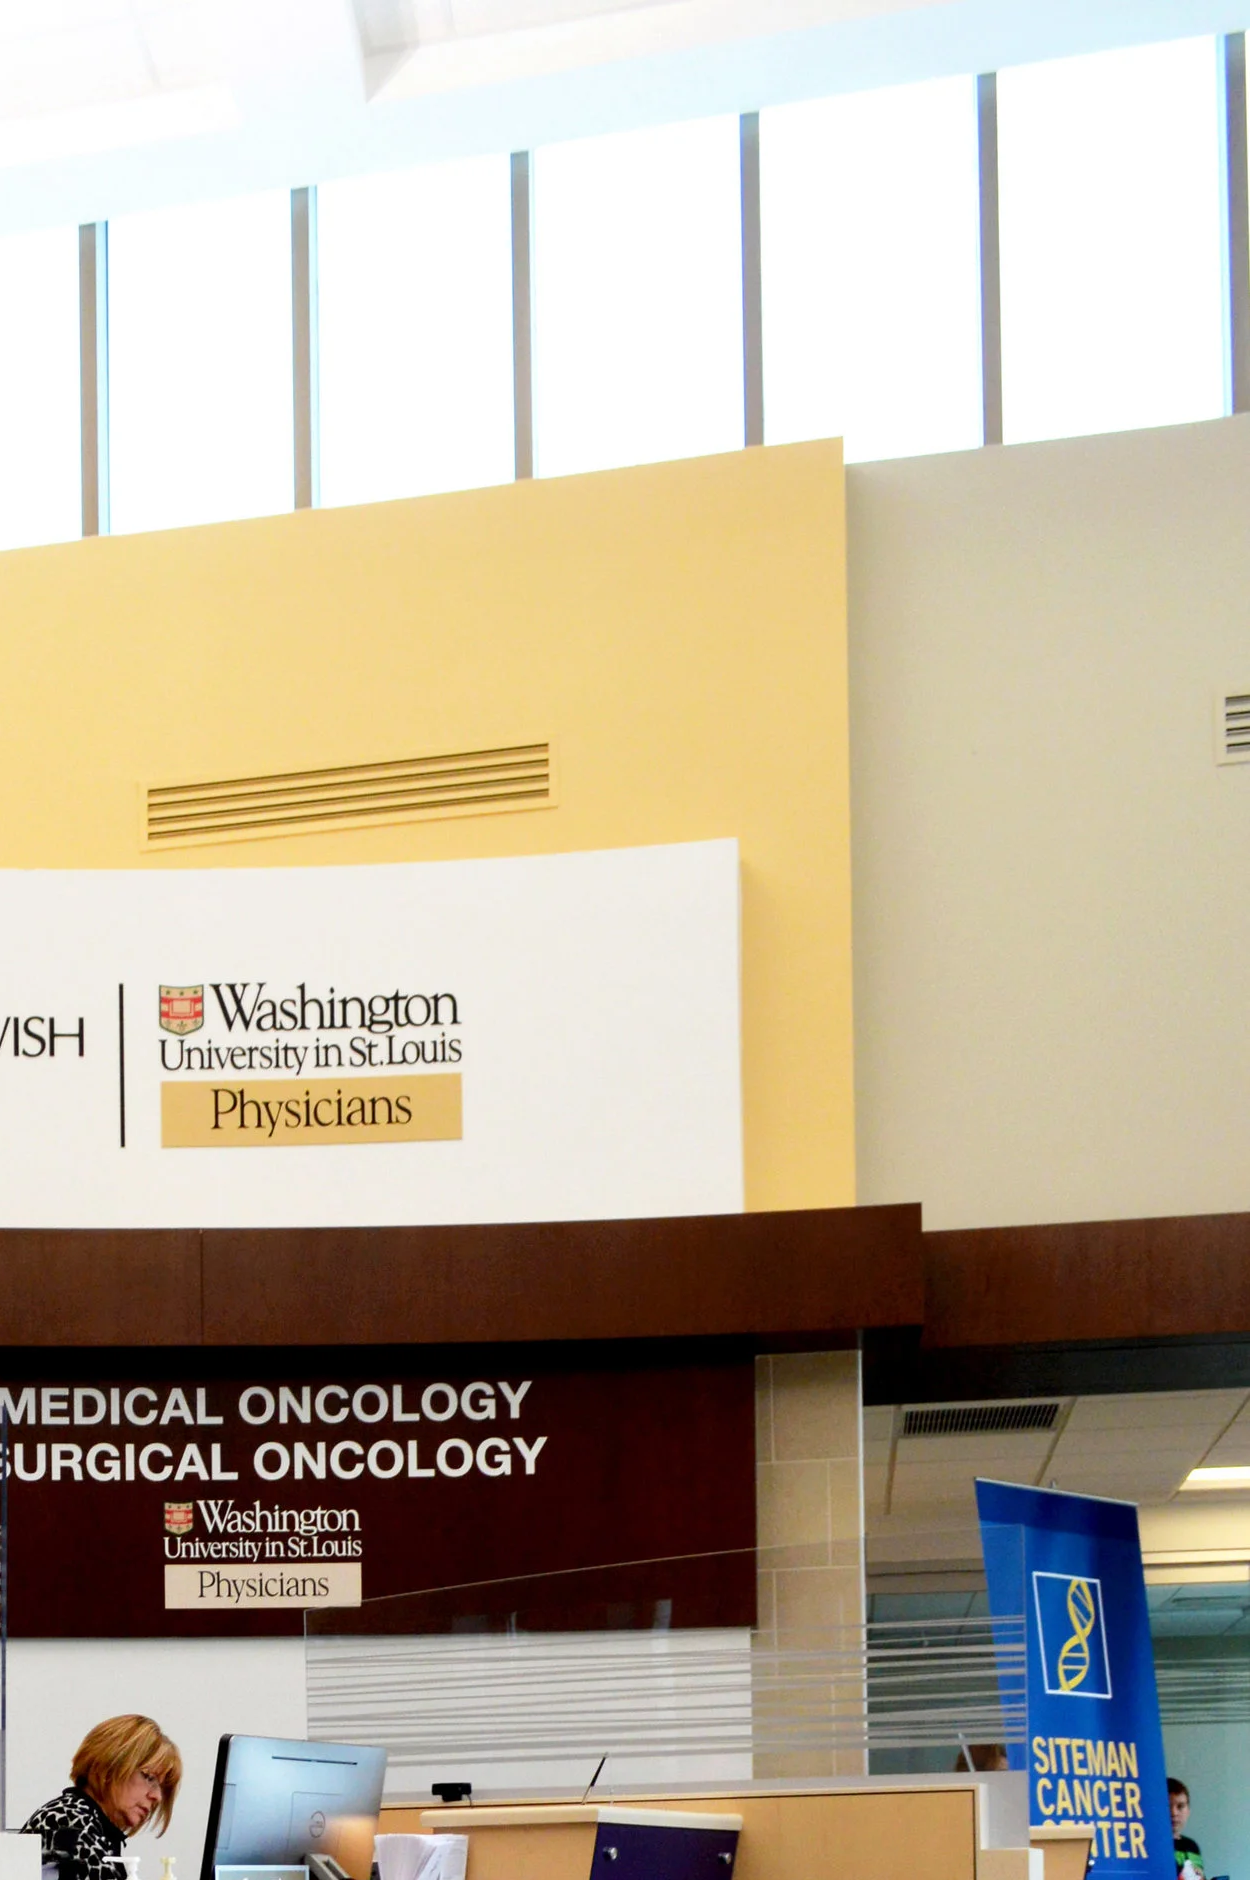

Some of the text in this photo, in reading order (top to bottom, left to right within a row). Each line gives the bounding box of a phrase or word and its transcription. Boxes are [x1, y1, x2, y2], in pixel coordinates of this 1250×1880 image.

[209, 982, 462, 1034] Washington
[158, 1038, 309, 1076] University
[314, 1037, 344, 1068] in
[211, 1088, 413, 1138] Physicians
[238, 1380, 533, 1425] ONCOLOGY
[253, 1437, 548, 1480] ONCOLOGY
[196, 1499, 363, 1536] Washington
[163, 1536, 262, 1562] University
[265, 1536, 286, 1557] in
[197, 1570, 331, 1604] Physicians
[1032, 1736, 1139, 1778] SITEMAN
[1036, 1777, 1144, 1819] CANCER
